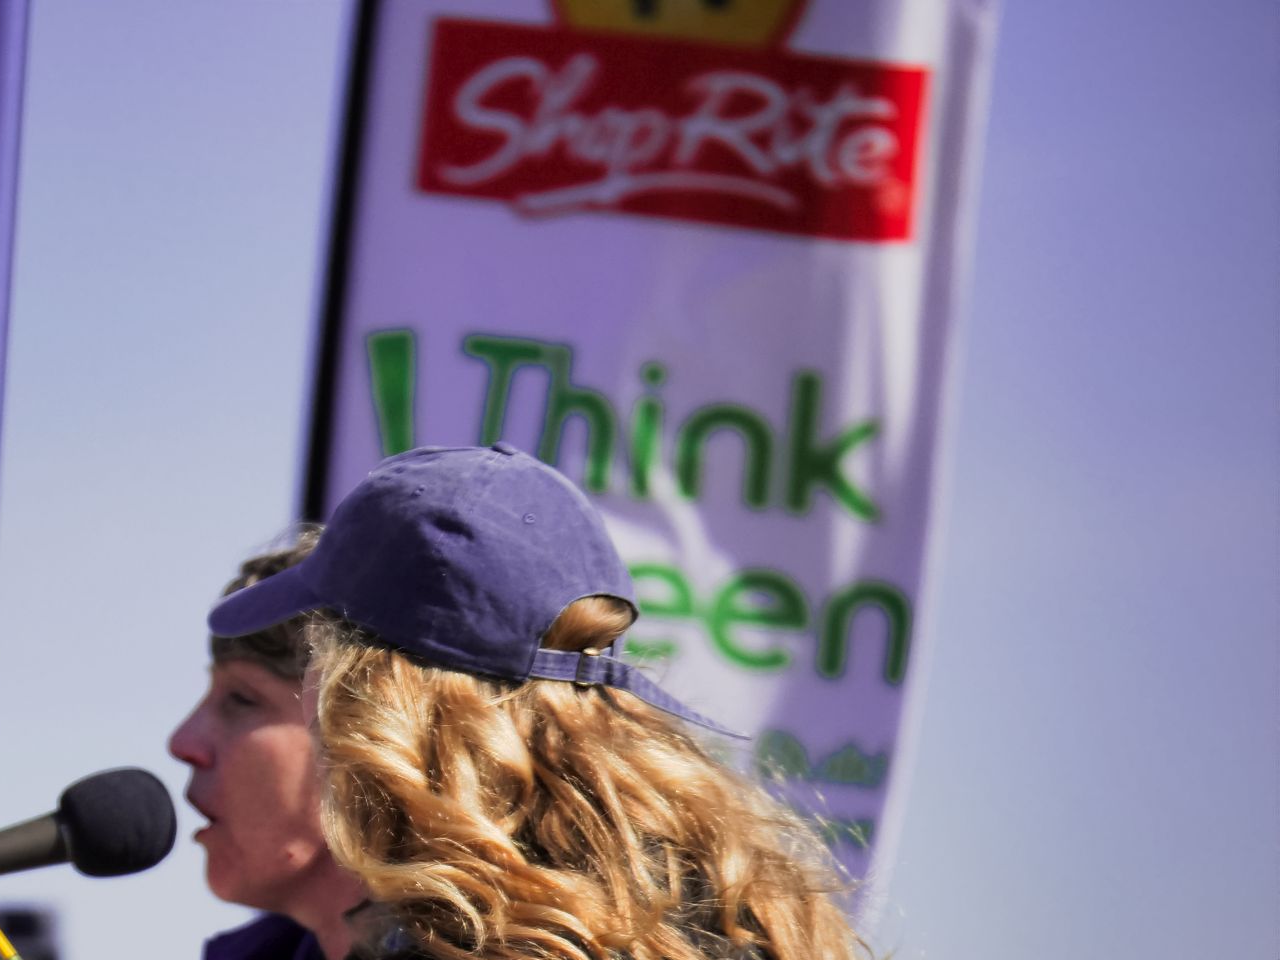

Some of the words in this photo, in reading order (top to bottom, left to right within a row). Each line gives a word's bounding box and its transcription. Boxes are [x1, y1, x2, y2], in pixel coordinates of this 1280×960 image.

[438, 53, 900, 202] ShopRite
[462, 334, 880, 522] Think
[626, 562, 913, 683] een
